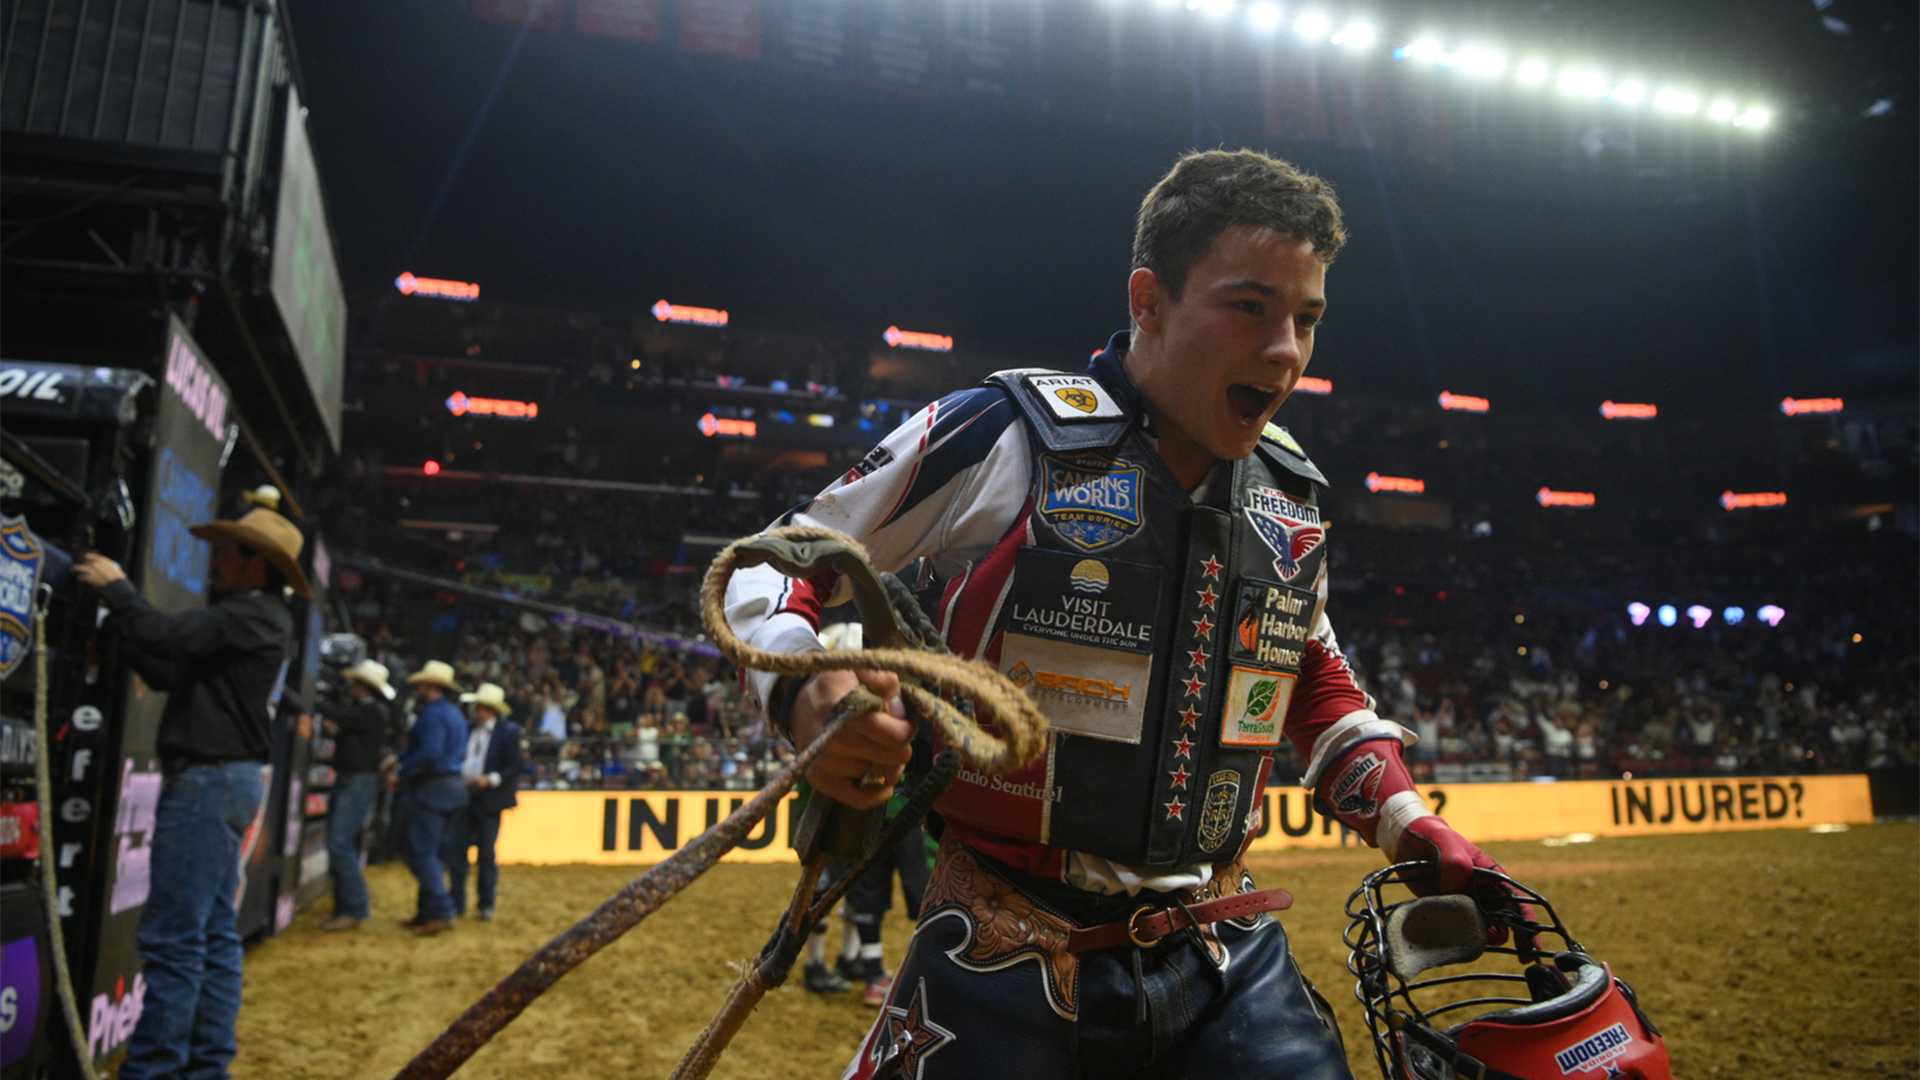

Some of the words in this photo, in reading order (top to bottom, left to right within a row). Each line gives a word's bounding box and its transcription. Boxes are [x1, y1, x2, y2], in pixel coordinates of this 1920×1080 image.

[0, 367, 64, 402] OIL
[1036, 377, 1092, 386] ARIAT
[1053, 468, 1130, 494] CAMPING
[1055, 484, 1130, 510] WORLD
[1252, 491, 1319, 526] FREEDOM
[1055, 512, 1085, 521] TEAM
[1087, 513, 1129, 529] SERIES
[1062, 594, 1112, 618] VISIT
[1264, 586, 1304, 616] Palm
[1012, 603, 1152, 641] LAUDERDALE
[1023, 623, 1069, 638] EVERYONE
[1070, 632, 1100, 643] UNDER
[1260, 611, 1308, 643] Harbor
[1256, 638, 1302, 667] Homes
[1611, 781, 1805, 826] INJURED?
[1556, 1023, 1631, 1073] FREEDOM
